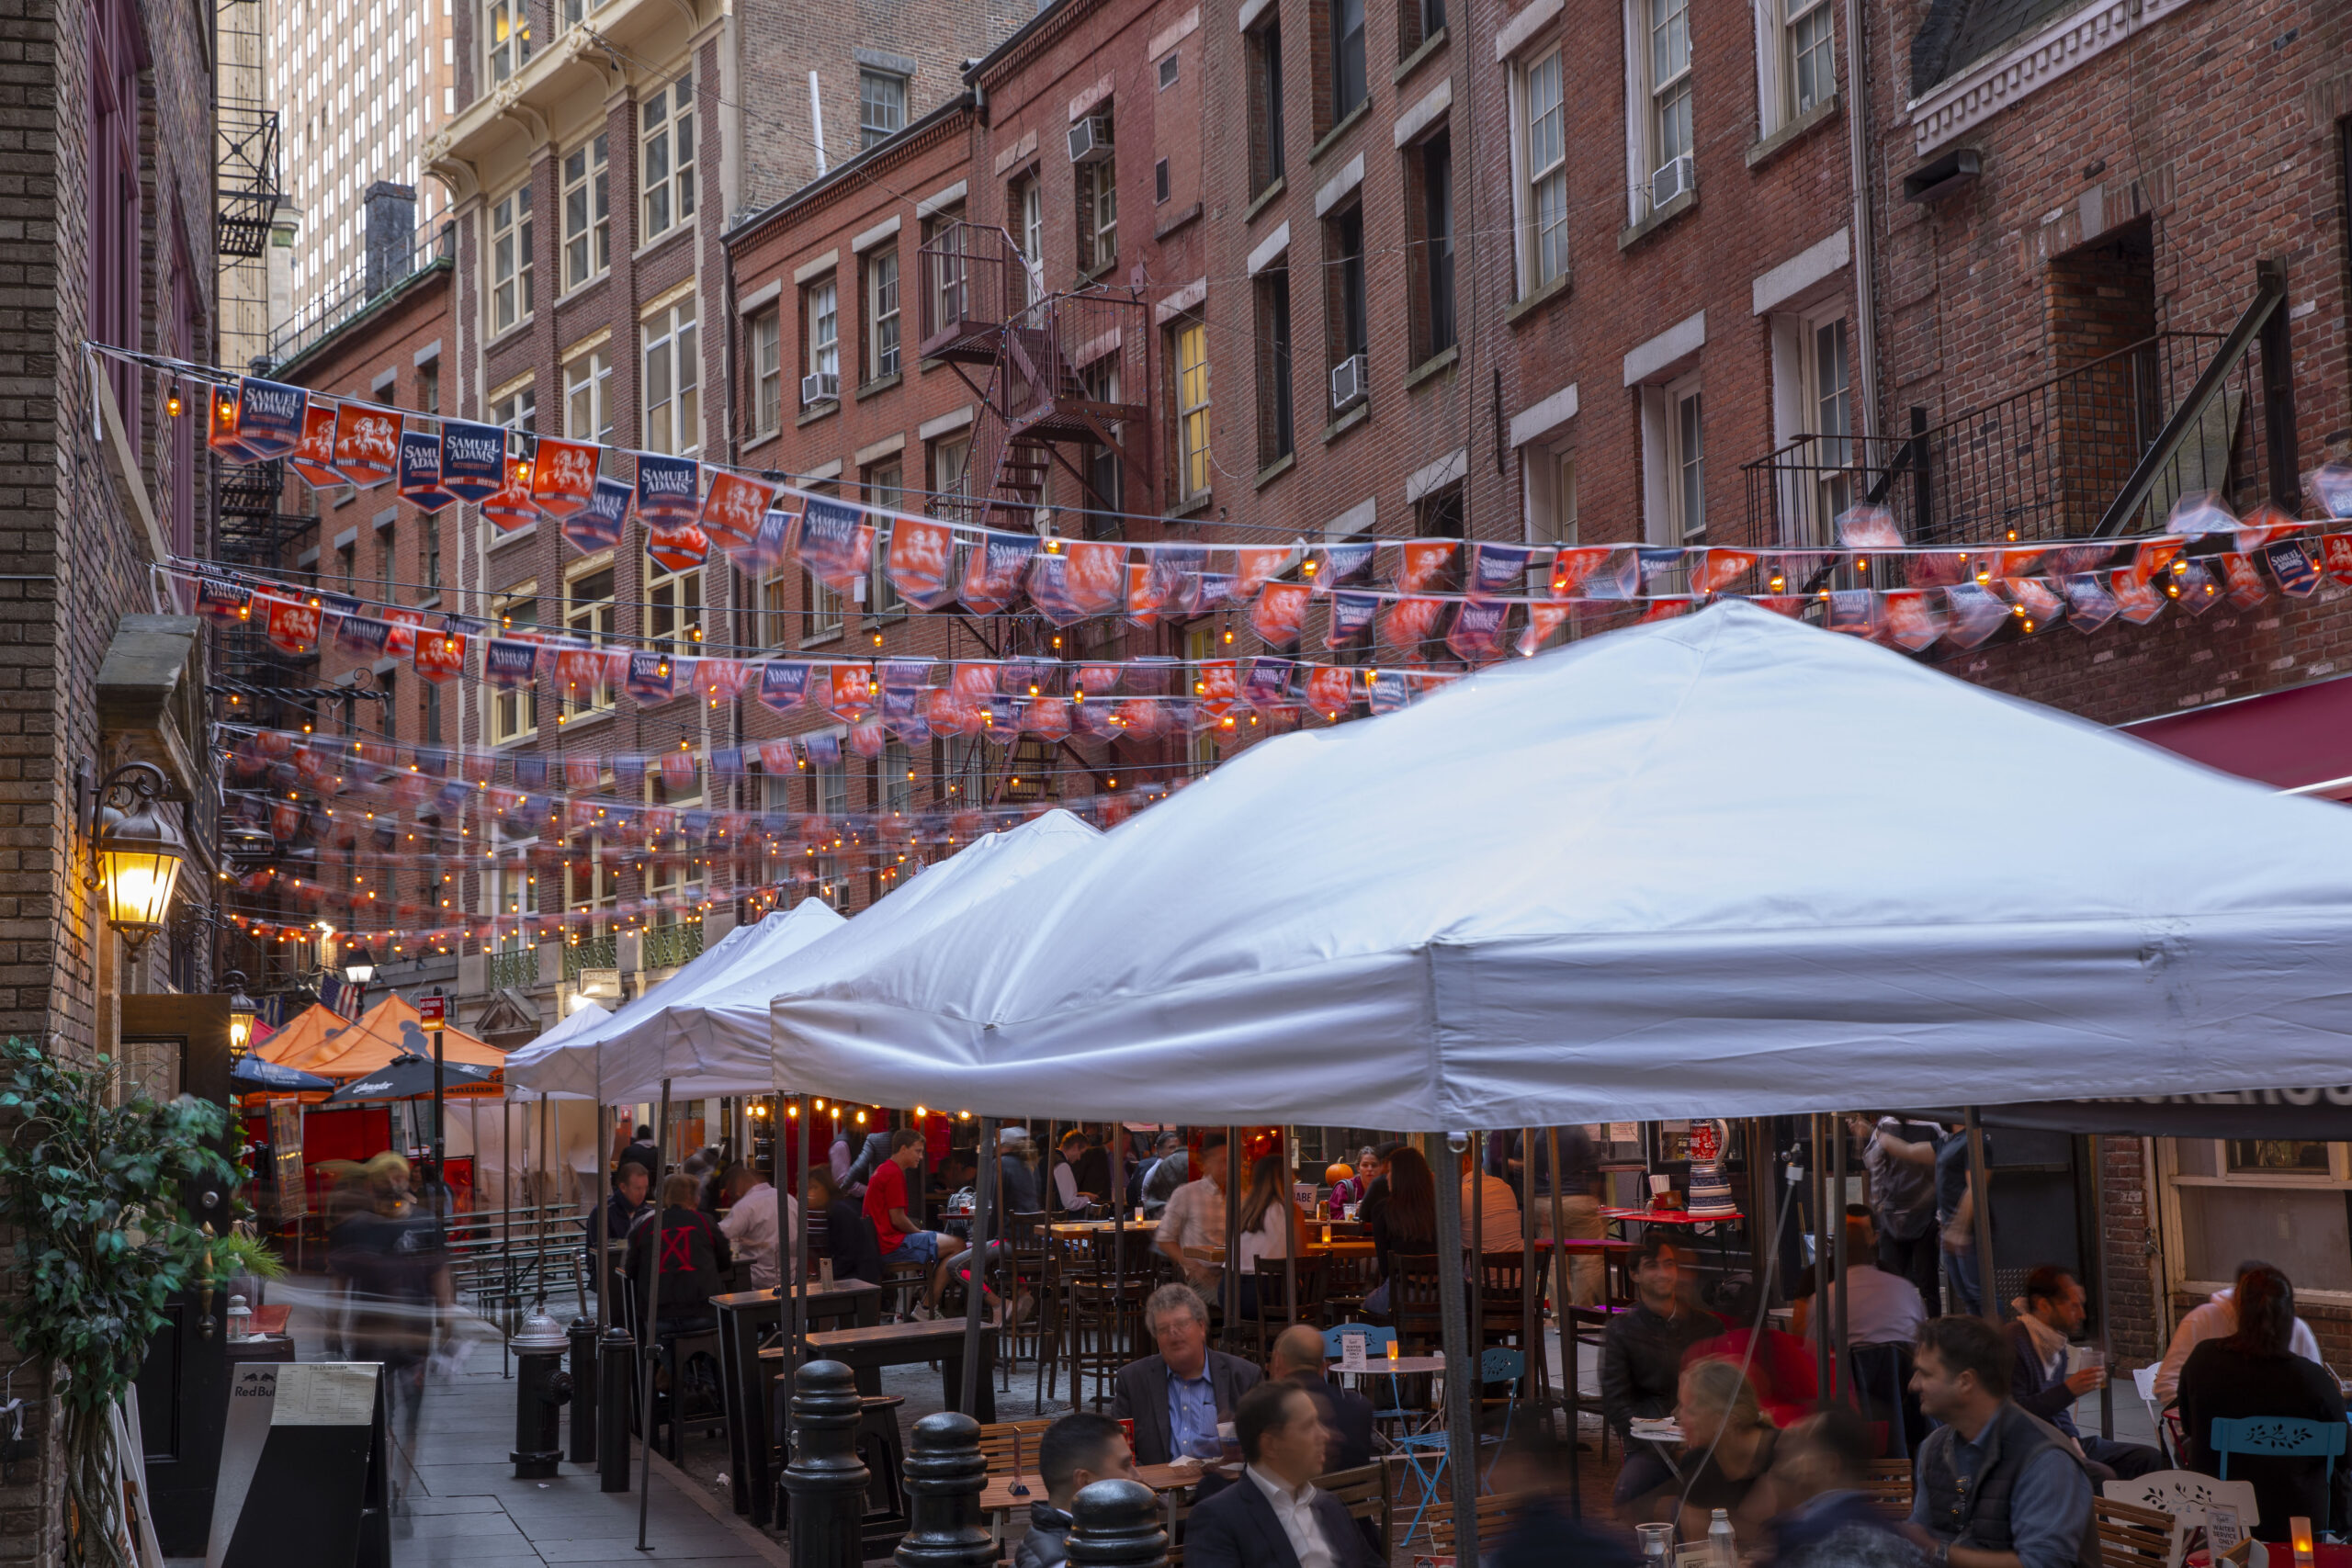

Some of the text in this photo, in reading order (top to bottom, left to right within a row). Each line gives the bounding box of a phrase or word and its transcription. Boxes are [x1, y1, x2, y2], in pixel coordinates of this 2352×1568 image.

[245, 387, 301, 409] SAMUEL
[247, 400, 295, 419] ADAMS
[447, 435, 501, 453] SAMUEL
[404, 445, 440, 459] SAMU
[450, 449, 495, 463] ADAMS
[642, 468, 694, 484] SAMUEL
[476, 479, 500, 489] BOSTON
[646, 480, 689, 494] ADAMS
[2270, 550, 2301, 566] SAMUEL
[2277, 559, 2304, 572] ADAMS
[1293, 1192, 1312, 1202] ABE
[235, 1386, 275, 1396] Red Bul
[2212, 1525, 2235, 1533] WAITER
[2212, 1530, 2237, 1540] SERVICE
